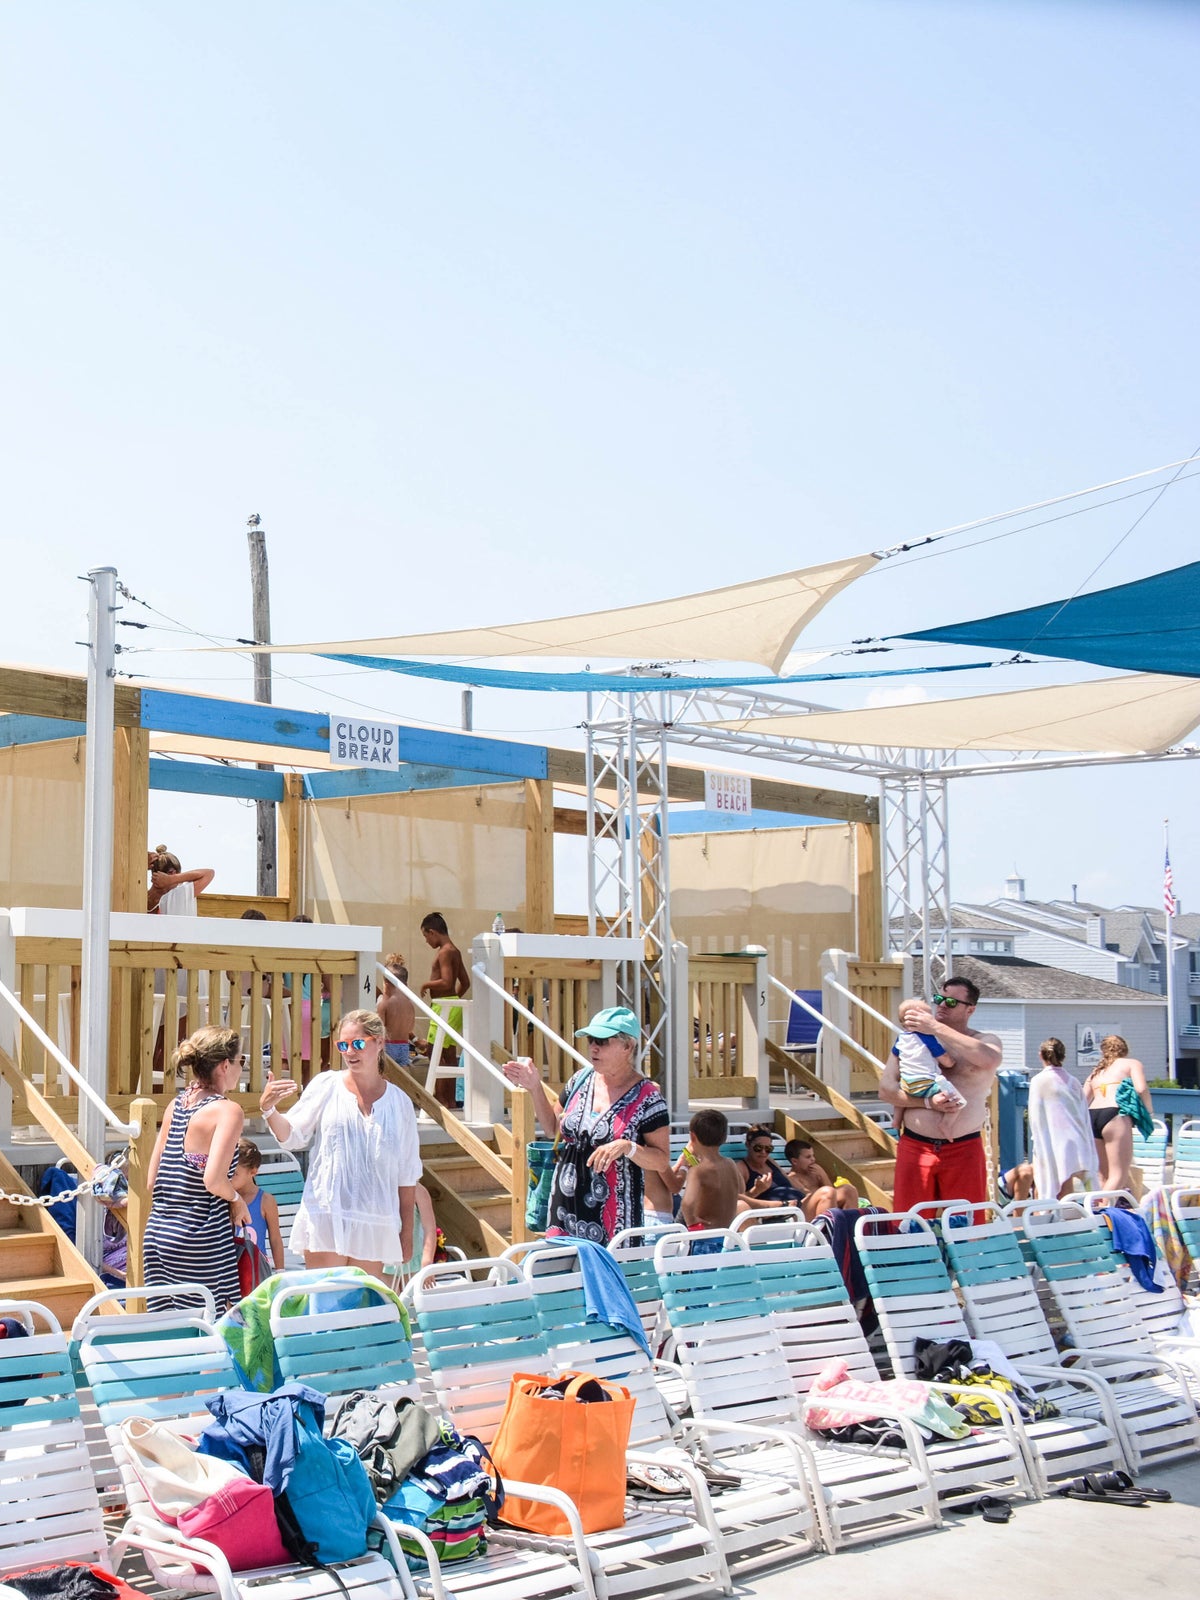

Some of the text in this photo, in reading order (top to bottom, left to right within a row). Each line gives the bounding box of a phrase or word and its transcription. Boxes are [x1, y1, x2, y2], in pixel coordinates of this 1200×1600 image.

[336, 722, 394, 746] CLOUD
[337, 741, 392, 764] BREAK
[710, 774, 747, 794] SUNSET
[716, 792, 747, 812] BEACH
[363, 974, 371, 994] 4
[760, 990, 766, 1007] 5
